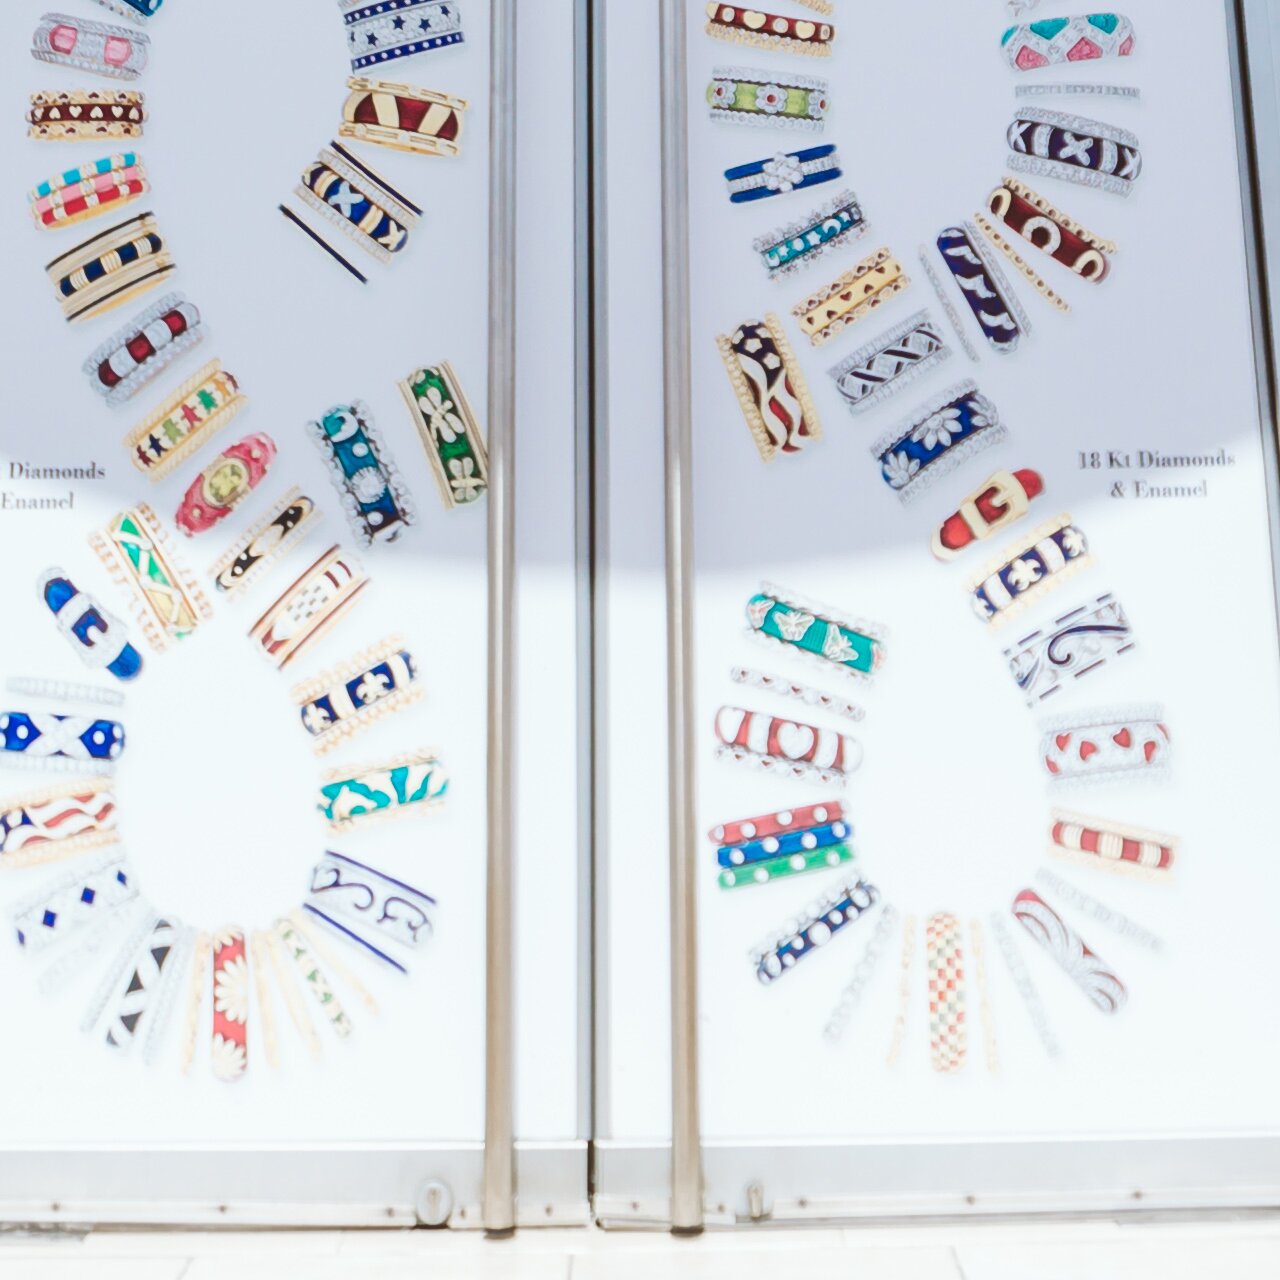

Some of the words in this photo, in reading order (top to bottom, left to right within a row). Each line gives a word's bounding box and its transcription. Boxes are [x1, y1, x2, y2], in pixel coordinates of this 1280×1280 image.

[1079, 451, 1101, 469] 18
[1108, 451, 1131, 469] Kt
[1138, 449, 1236, 469] Diamonds
[9, 460, 106, 479] Diamonds
[1110, 481, 1126, 499] &
[1134, 479, 1207, 498] Enamel
[1, 491, 74, 510] Enamel
